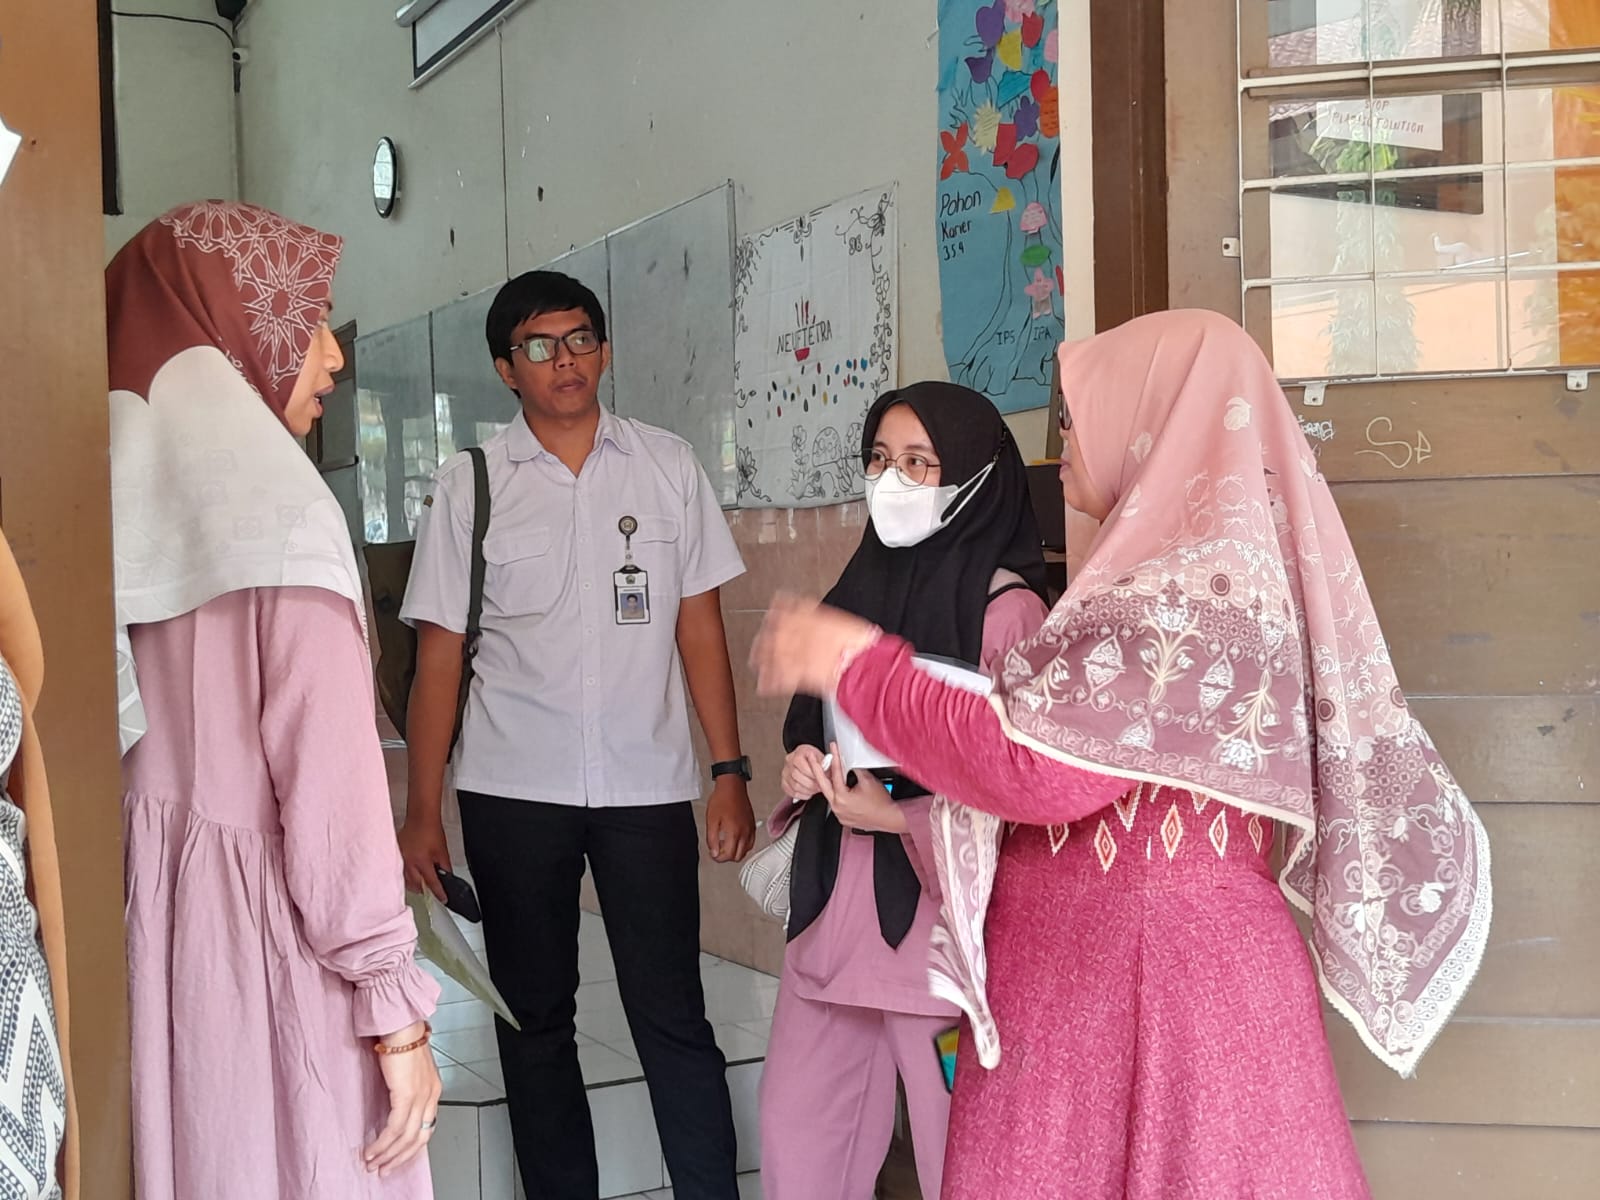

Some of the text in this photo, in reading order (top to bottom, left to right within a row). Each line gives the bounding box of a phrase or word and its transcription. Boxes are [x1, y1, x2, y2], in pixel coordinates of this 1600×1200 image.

[939, 189, 982, 218] Pohon
[996, 329, 1016, 345] IPS
[1033, 326, 1052, 341] IPA
